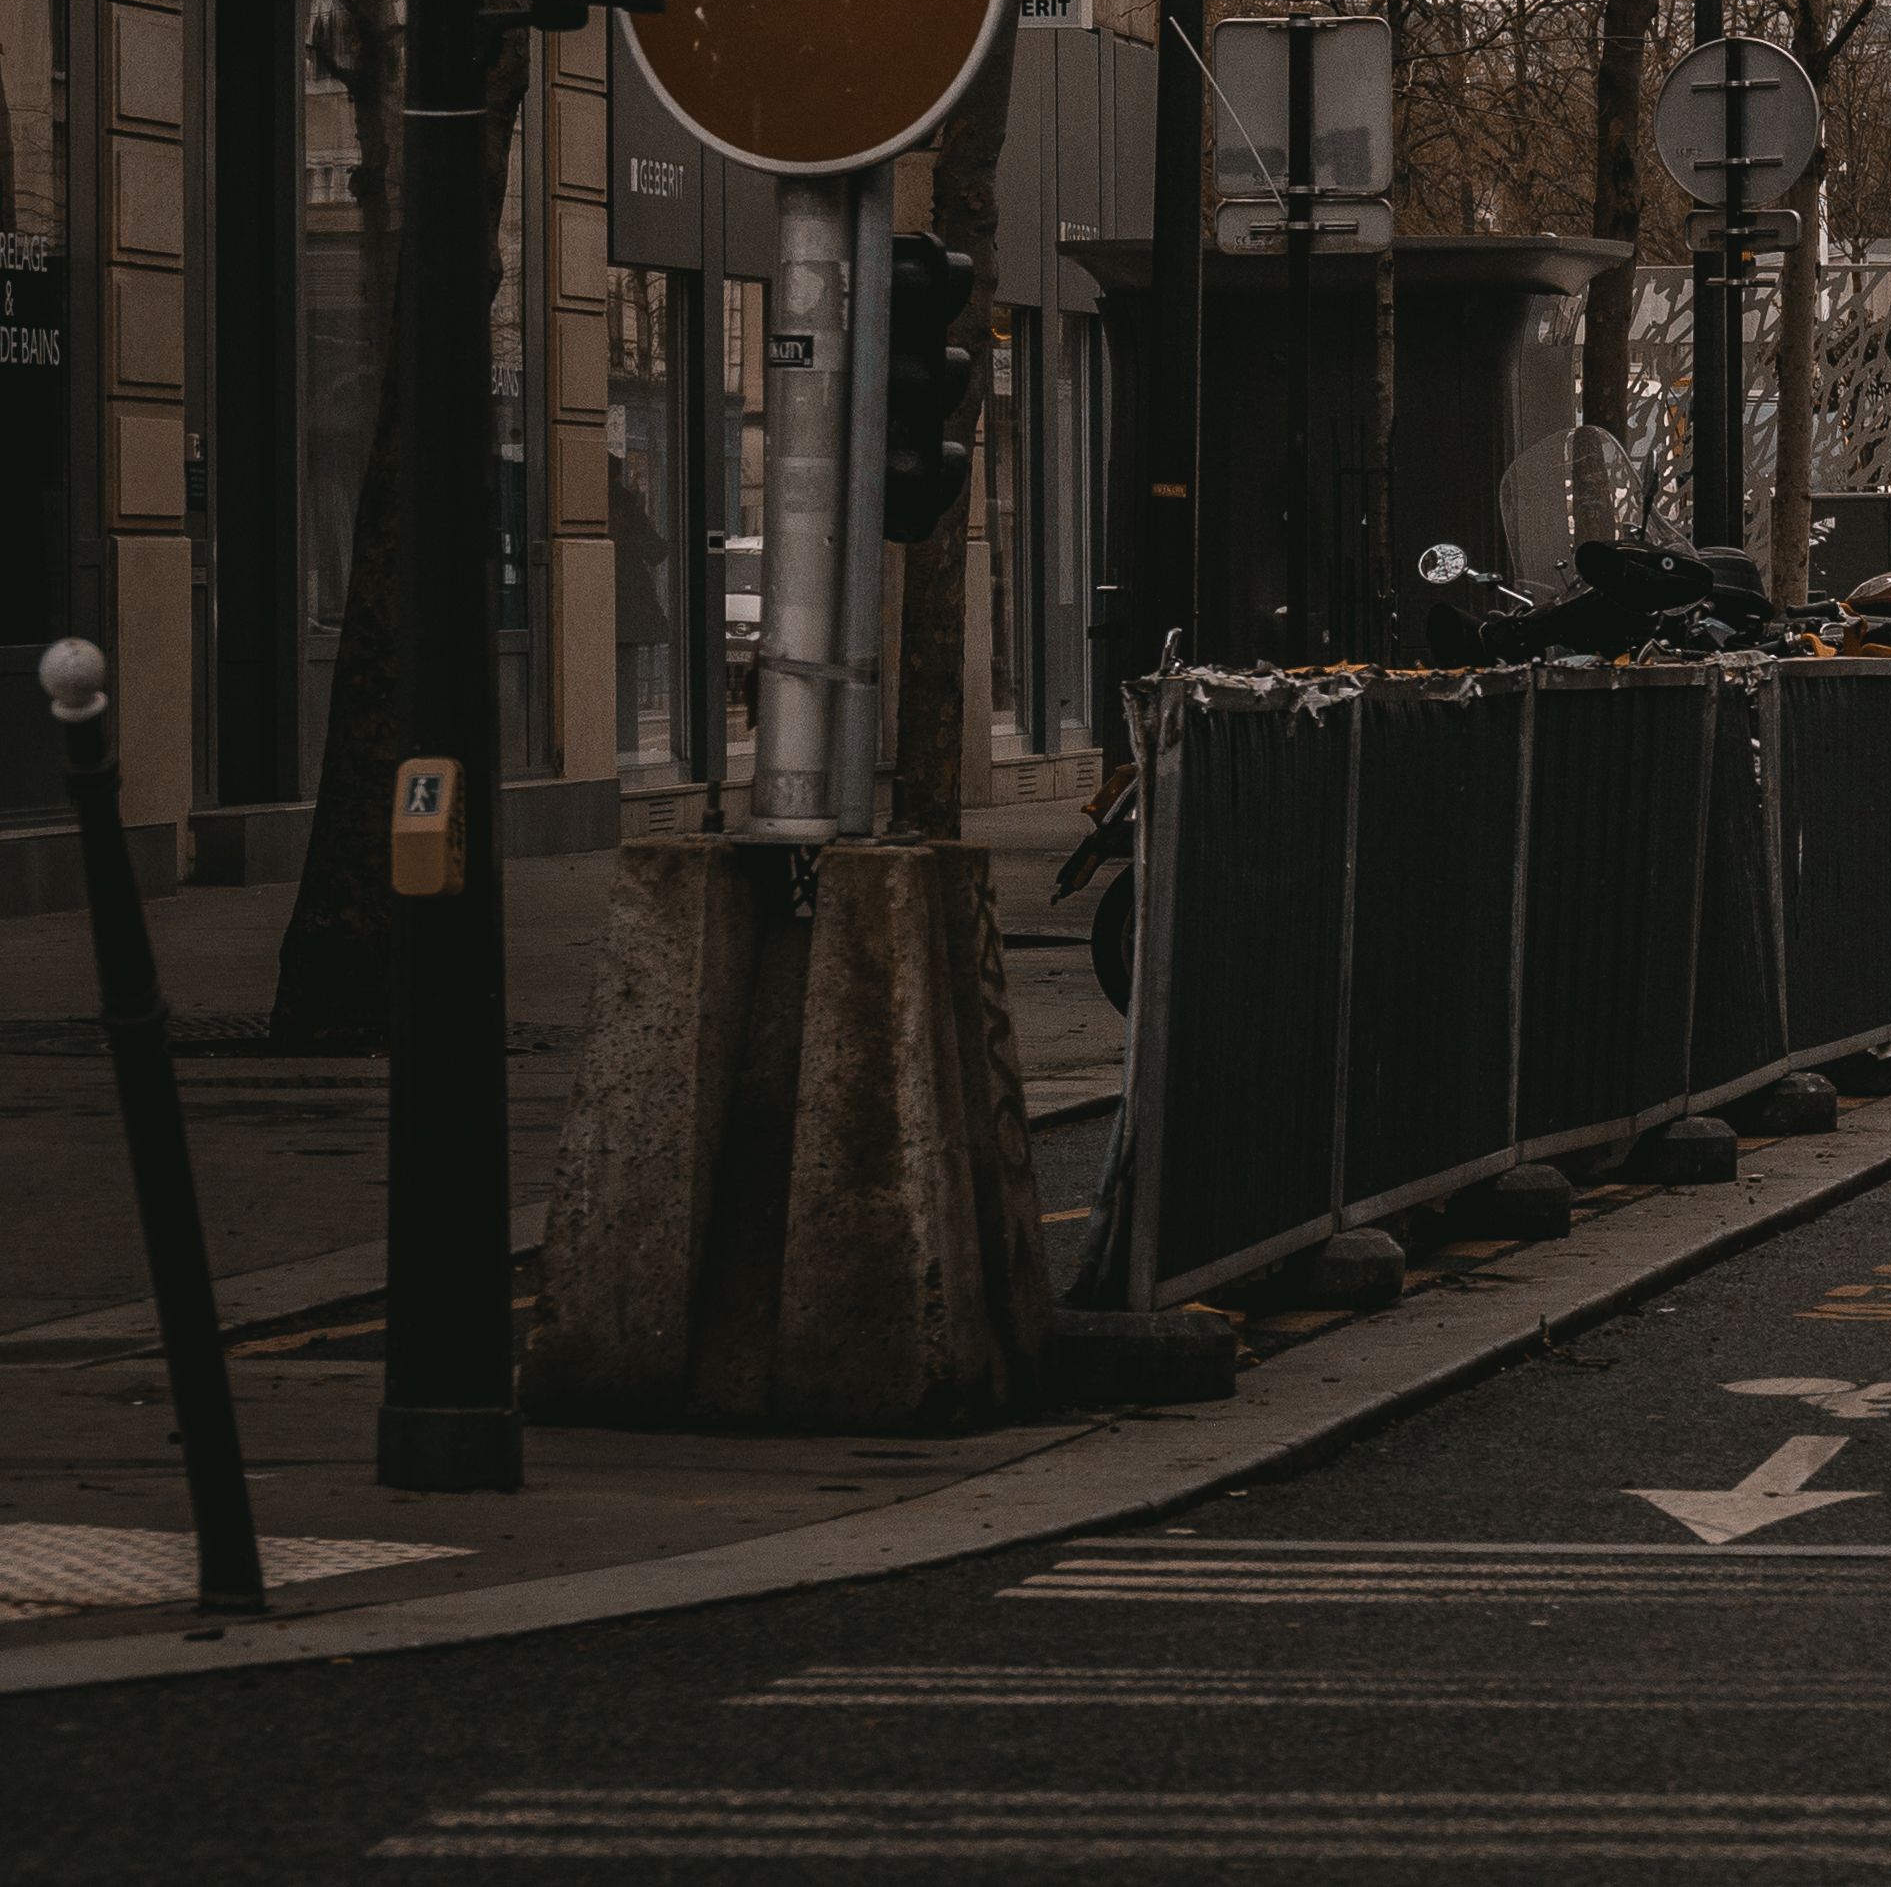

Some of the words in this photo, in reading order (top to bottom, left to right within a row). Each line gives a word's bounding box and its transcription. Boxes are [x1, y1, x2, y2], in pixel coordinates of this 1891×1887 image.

[638, 159, 684, 201] GEBERIT
[4, 280, 15, 317] &
[0, 325, 18, 363] DE
[21, 326, 61, 367] BAINS
